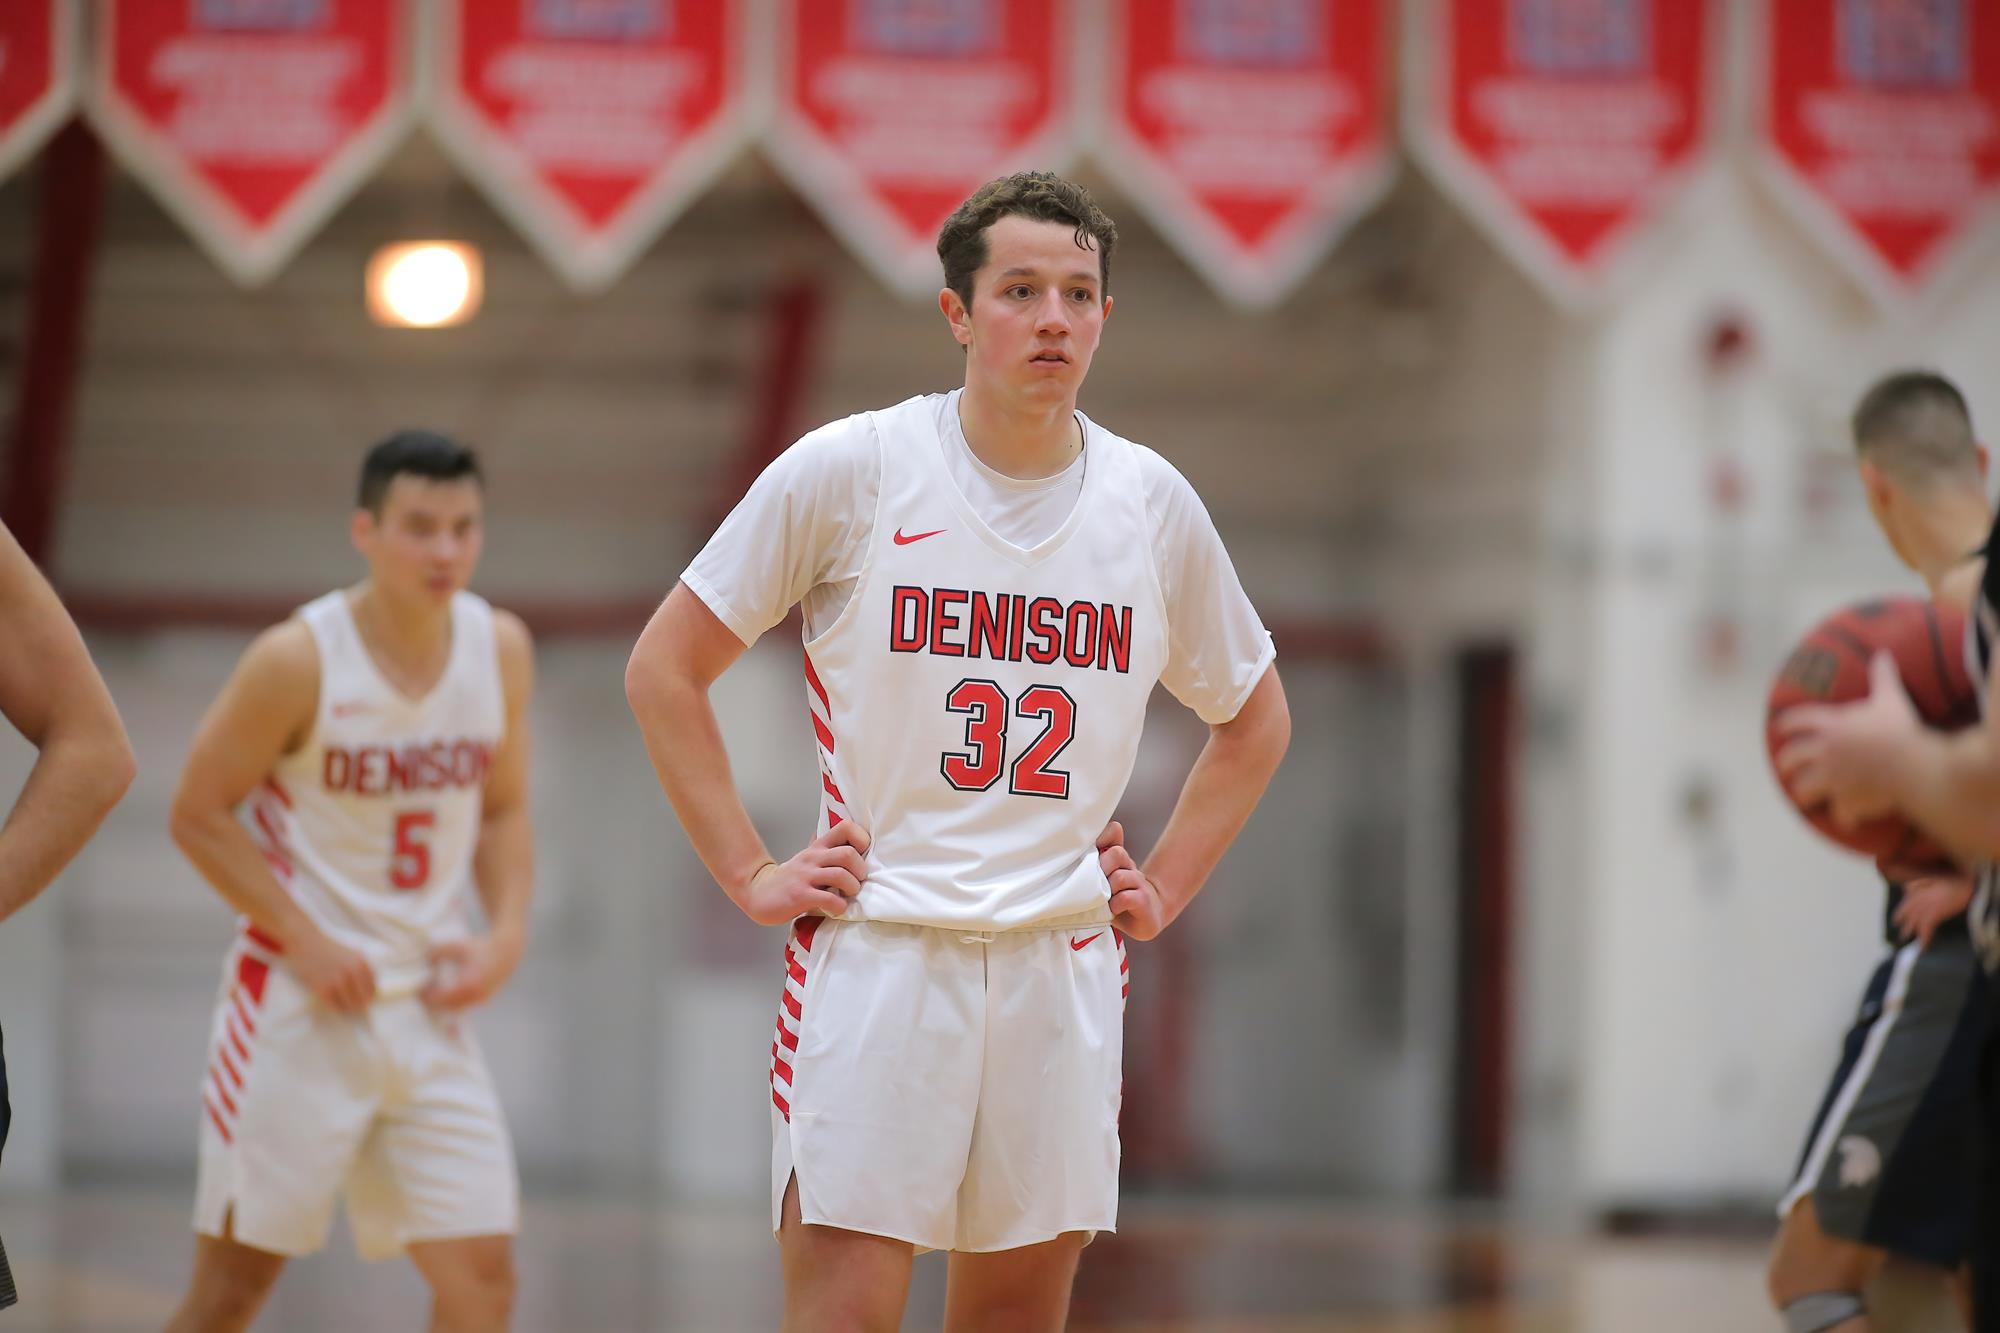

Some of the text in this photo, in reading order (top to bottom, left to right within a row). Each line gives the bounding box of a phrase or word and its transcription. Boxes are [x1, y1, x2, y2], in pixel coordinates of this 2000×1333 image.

[890, 585, 1133, 674] DENISON
[940, 677, 1077, 800] 32
[390, 810, 436, 890] 5
